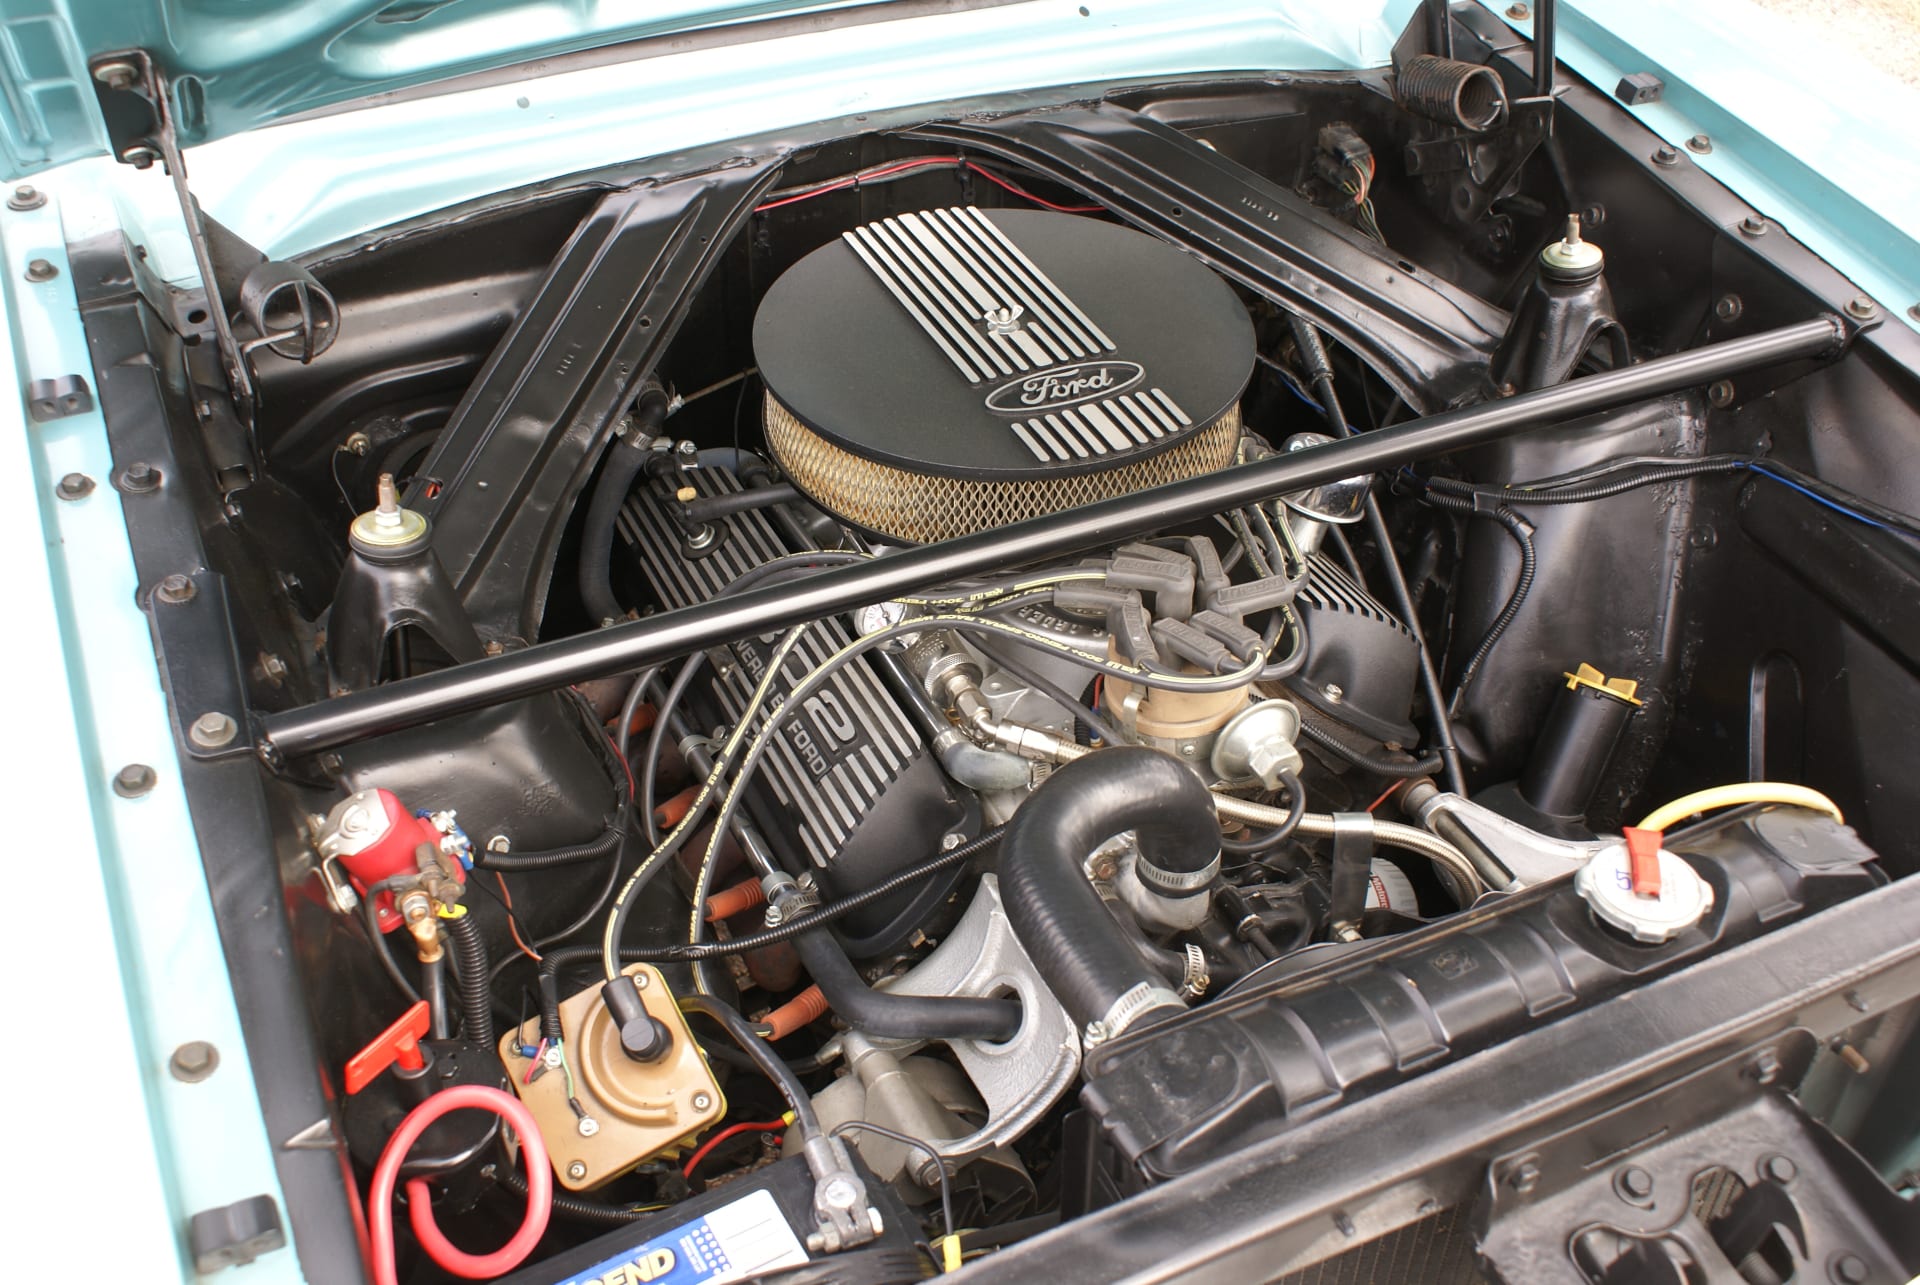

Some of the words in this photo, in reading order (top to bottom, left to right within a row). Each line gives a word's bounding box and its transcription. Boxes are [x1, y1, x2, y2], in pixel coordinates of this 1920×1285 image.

[1020, 367, 1114, 405] Ford
[1071, 649, 1105, 663] 300+
[786, 719, 827, 775] FORD
[695, 785, 711, 806] 300+
[653, 806, 698, 855] FERRO-SPIRAL
[634, 854, 656, 878] RACE
[616, 878, 637, 906] WIRE
[1371, 876, 1389, 909] Motorc
[581, 1246, 677, 1285] END
